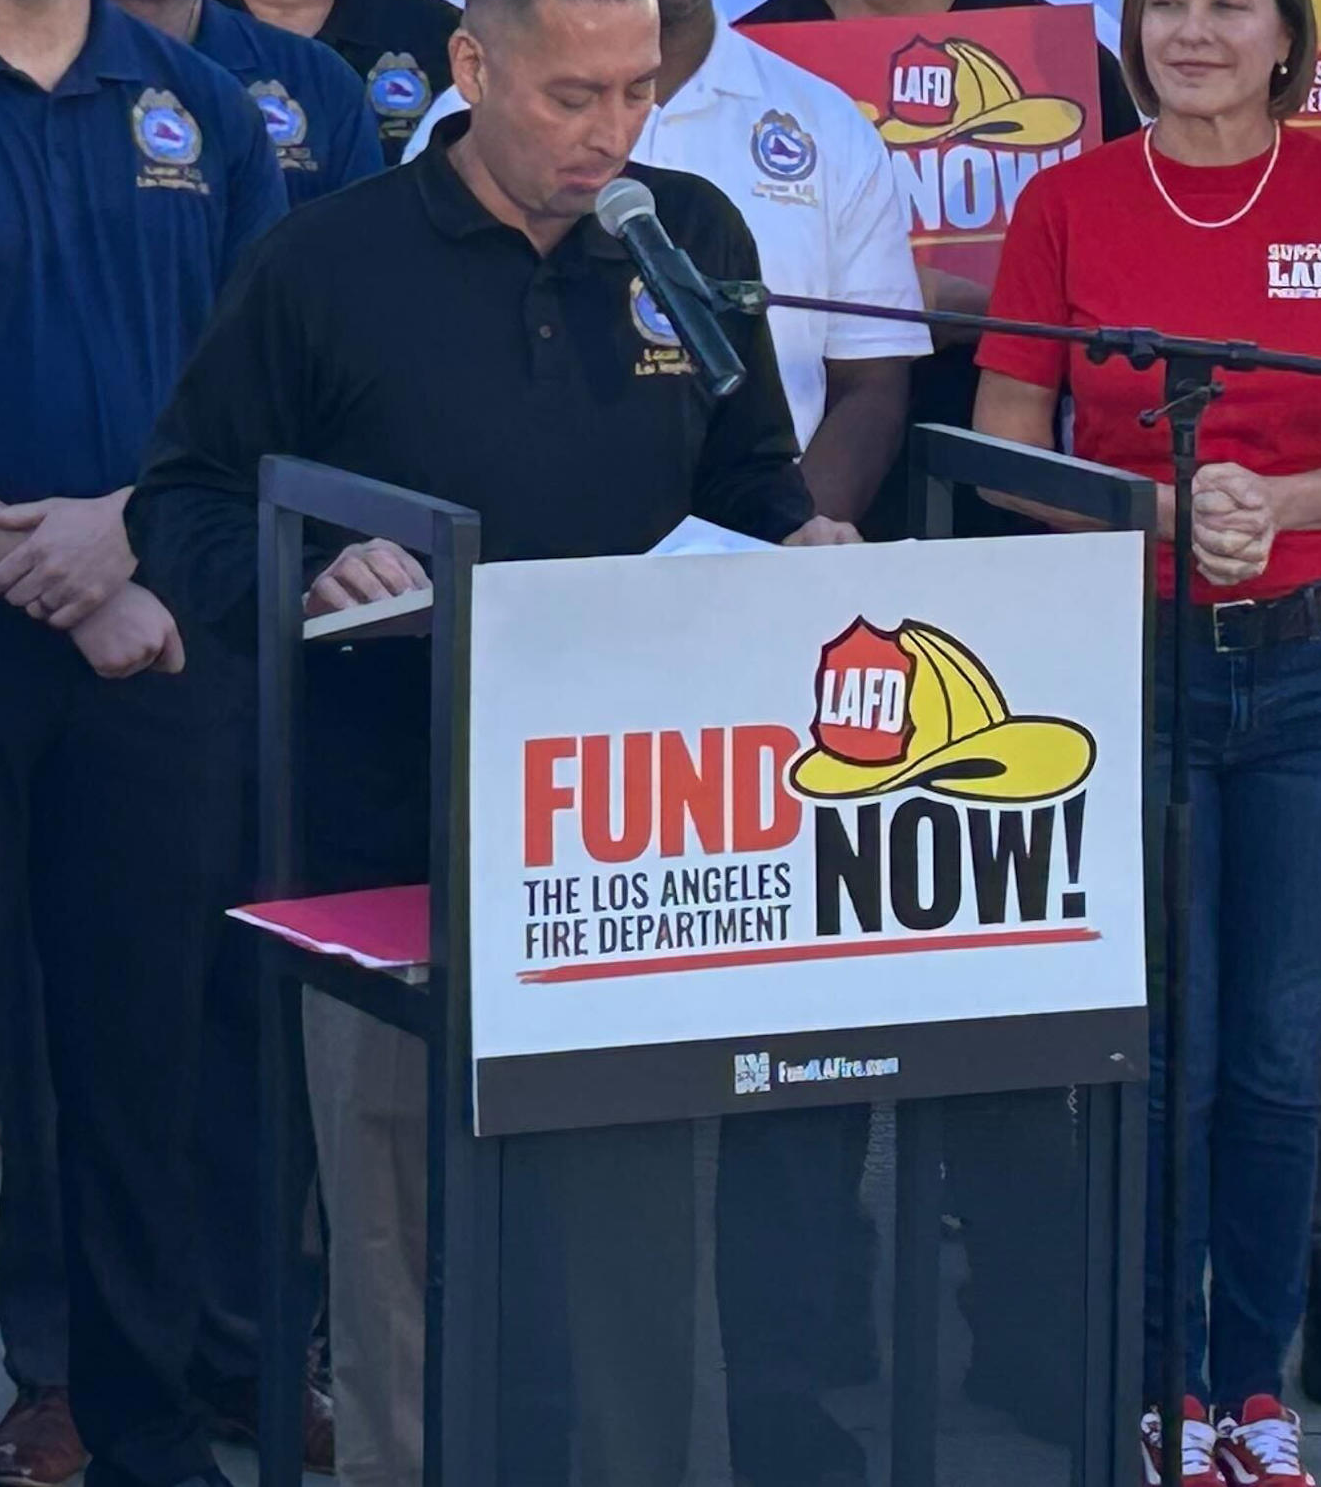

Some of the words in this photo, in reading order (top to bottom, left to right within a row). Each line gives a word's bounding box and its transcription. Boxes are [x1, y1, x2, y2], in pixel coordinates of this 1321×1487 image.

[893, 66, 953, 107] LAFD
[821, 666, 907, 734] LAFD
[523, 723, 803, 868] FUND
[523, 877, 581, 917] THE
[591, 871, 650, 912] LOS
[660, 861, 792, 907] ANGELES
[814, 790, 1087, 938] NOW!
[526, 918, 589, 960] FIRE
[598, 904, 793, 954] DEPARTMENT
